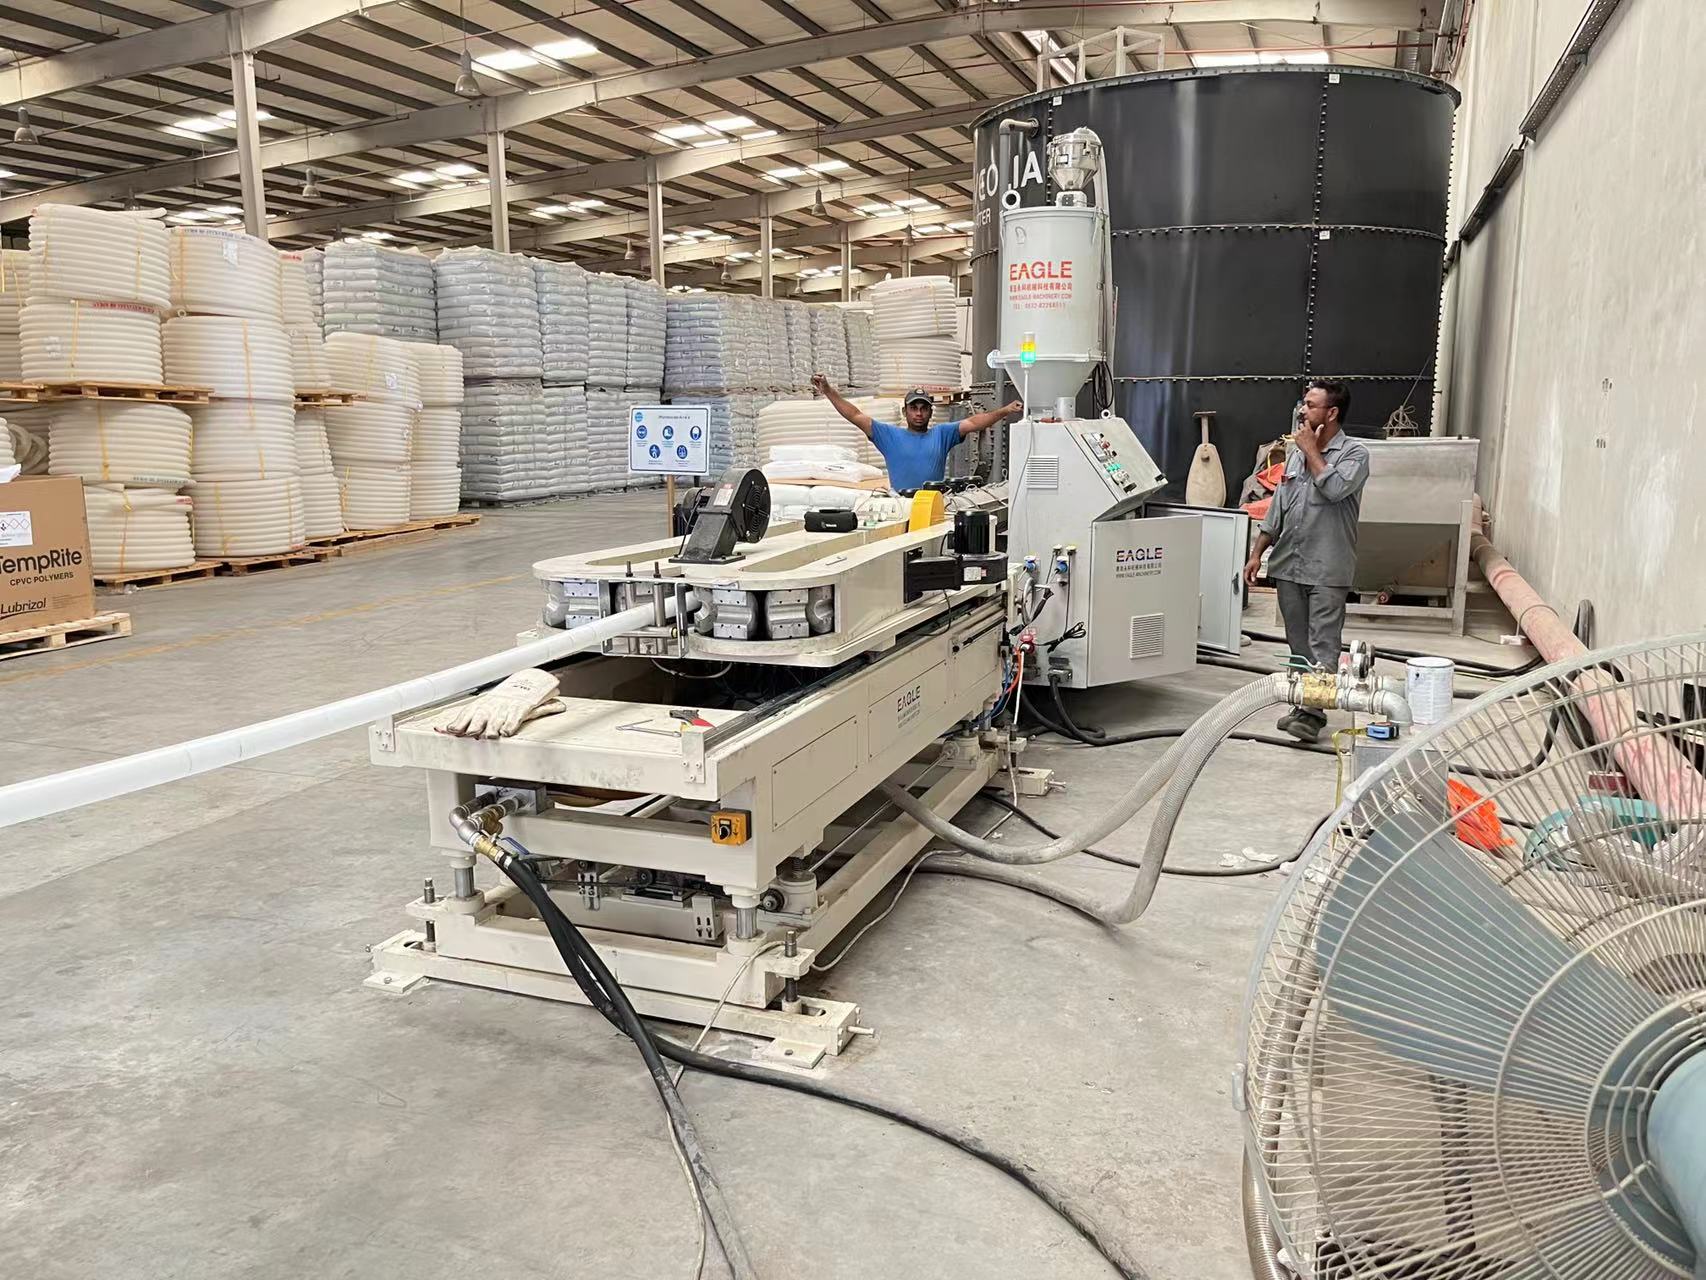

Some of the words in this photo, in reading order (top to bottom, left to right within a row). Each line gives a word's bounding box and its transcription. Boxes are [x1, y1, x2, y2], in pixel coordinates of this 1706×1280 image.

[975, 151, 1044, 203] EOIA
[1009, 260, 1073, 281] EAGLE
[1116, 547, 1163, 562] EAGLE
[9, 577, 32, 586] CPVC
[33, 571, 74, 583] POLYMERS
[0, 597, 47, 615] Lubrizol
[897, 685, 921, 713] EAGLE
